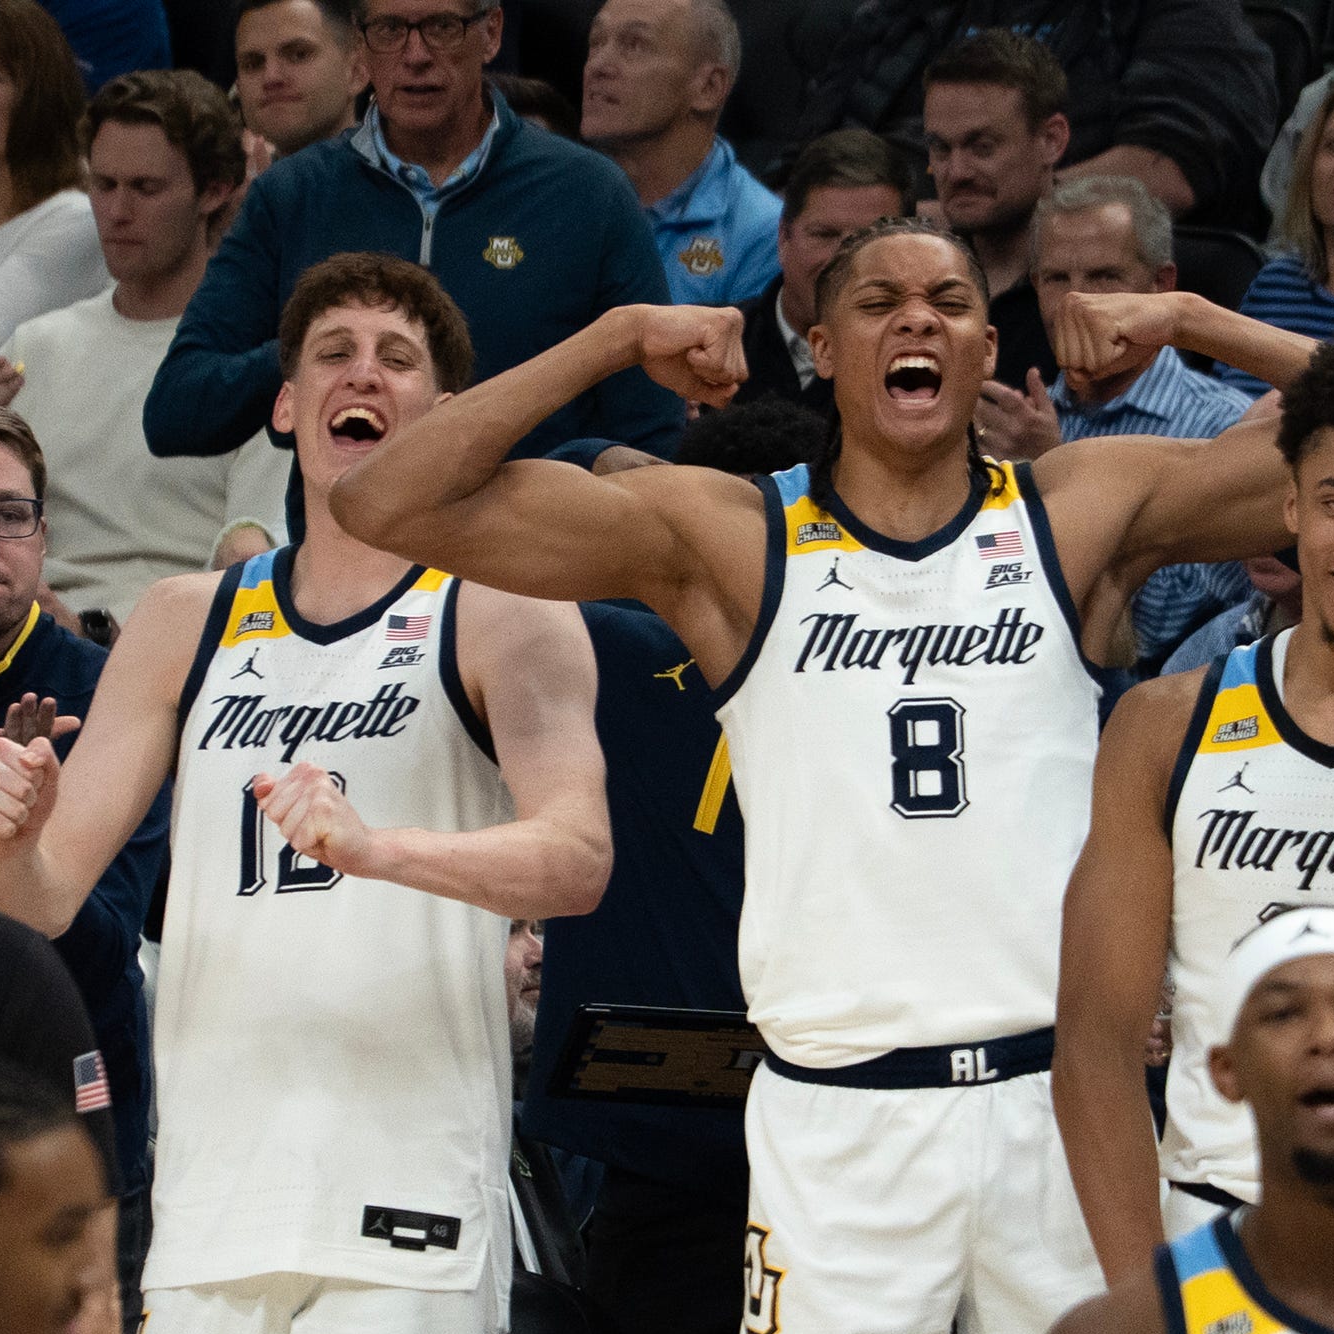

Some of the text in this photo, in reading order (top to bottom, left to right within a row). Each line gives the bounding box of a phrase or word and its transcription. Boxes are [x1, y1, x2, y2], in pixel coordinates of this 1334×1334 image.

[798, 522, 836, 535] BE THE
[796, 530, 840, 545] CHANGE
[990, 562, 1022, 574] BIG
[986, 571, 1033, 584] EAST
[388, 646, 420, 656] BIG
[794, 607, 1045, 685] Marquette
[379, 653, 426, 665] EAST
[198, 682, 421, 764] Marquette
[1218, 716, 1256, 734] BE THE
[1212, 727, 1257, 742] CHANGE
[886, 697, 970, 819] 8
[950, 1047, 999, 1082] AL
